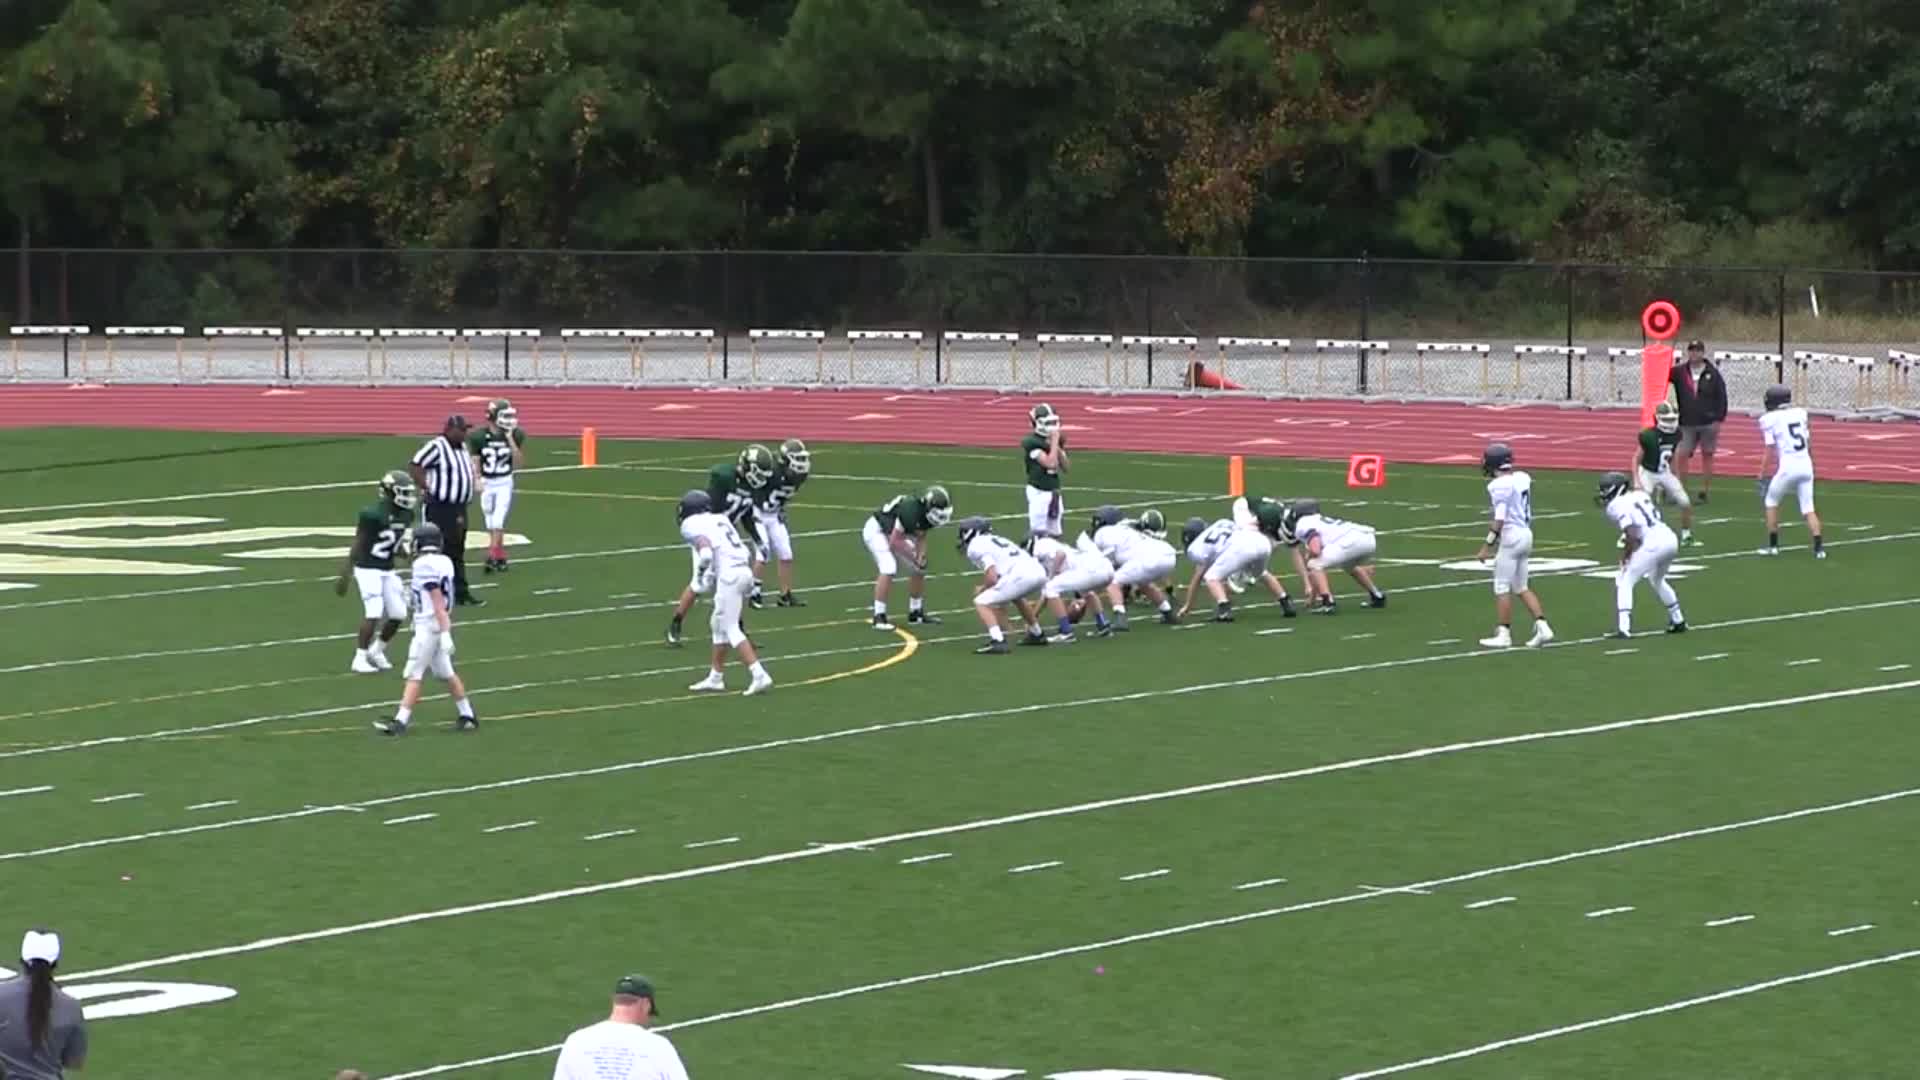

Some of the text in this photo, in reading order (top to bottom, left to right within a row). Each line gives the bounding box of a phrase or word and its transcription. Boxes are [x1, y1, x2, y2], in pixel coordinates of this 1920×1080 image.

[1788, 422, 1806, 451] 5
[481, 447, 511, 474] 32
[1353, 457, 1377, 484] G
